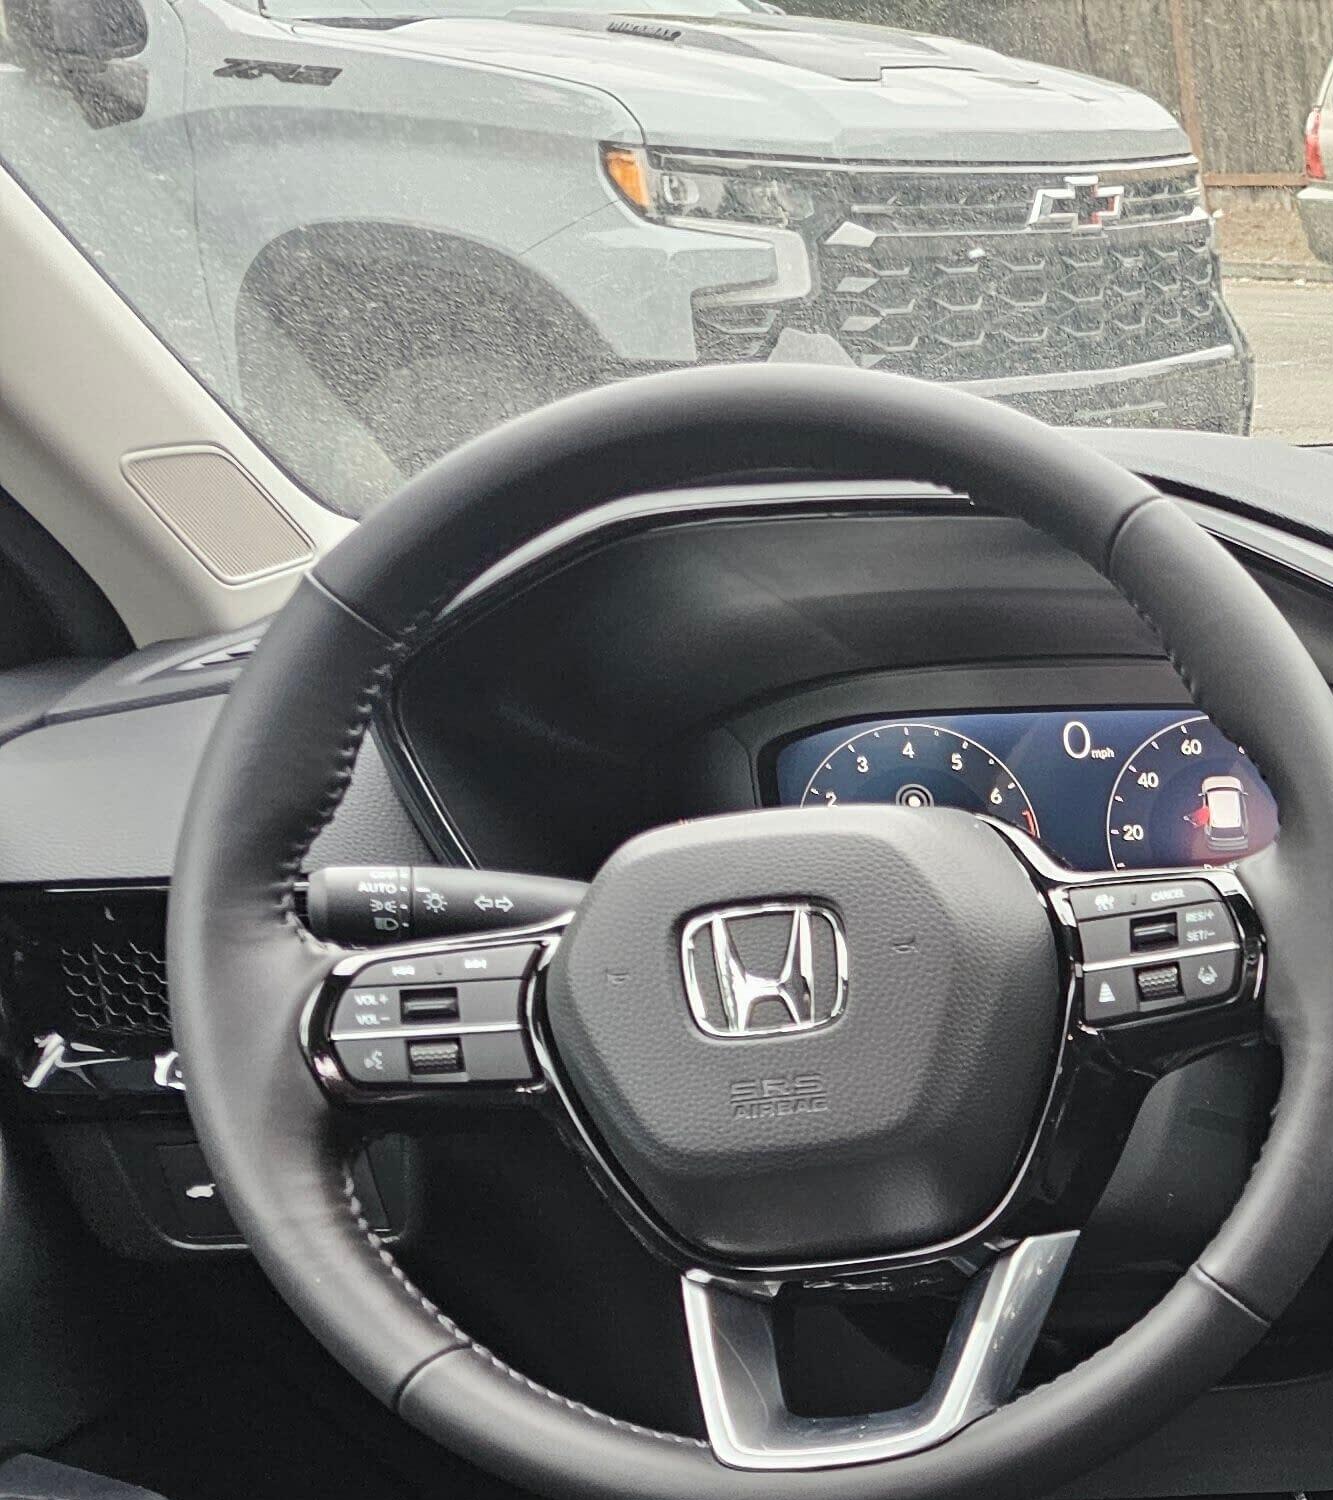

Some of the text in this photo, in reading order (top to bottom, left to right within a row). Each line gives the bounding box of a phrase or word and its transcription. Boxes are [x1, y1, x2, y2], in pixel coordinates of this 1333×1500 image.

[1063, 721, 1091, 760] 0
[1181, 739, 1203, 756] 60
[902, 742, 914, 758] 4
[1091, 745, 1115, 760] mph
[857, 757, 869, 773] 3
[951, 754, 963, 771] 5
[1137, 772, 1159, 788] 40
[990, 788, 1002, 805] 6
[1123, 824, 1144, 841] 20
[358, 882, 397, 894] AUTO
[731, 1073, 824, 1097] SRS
